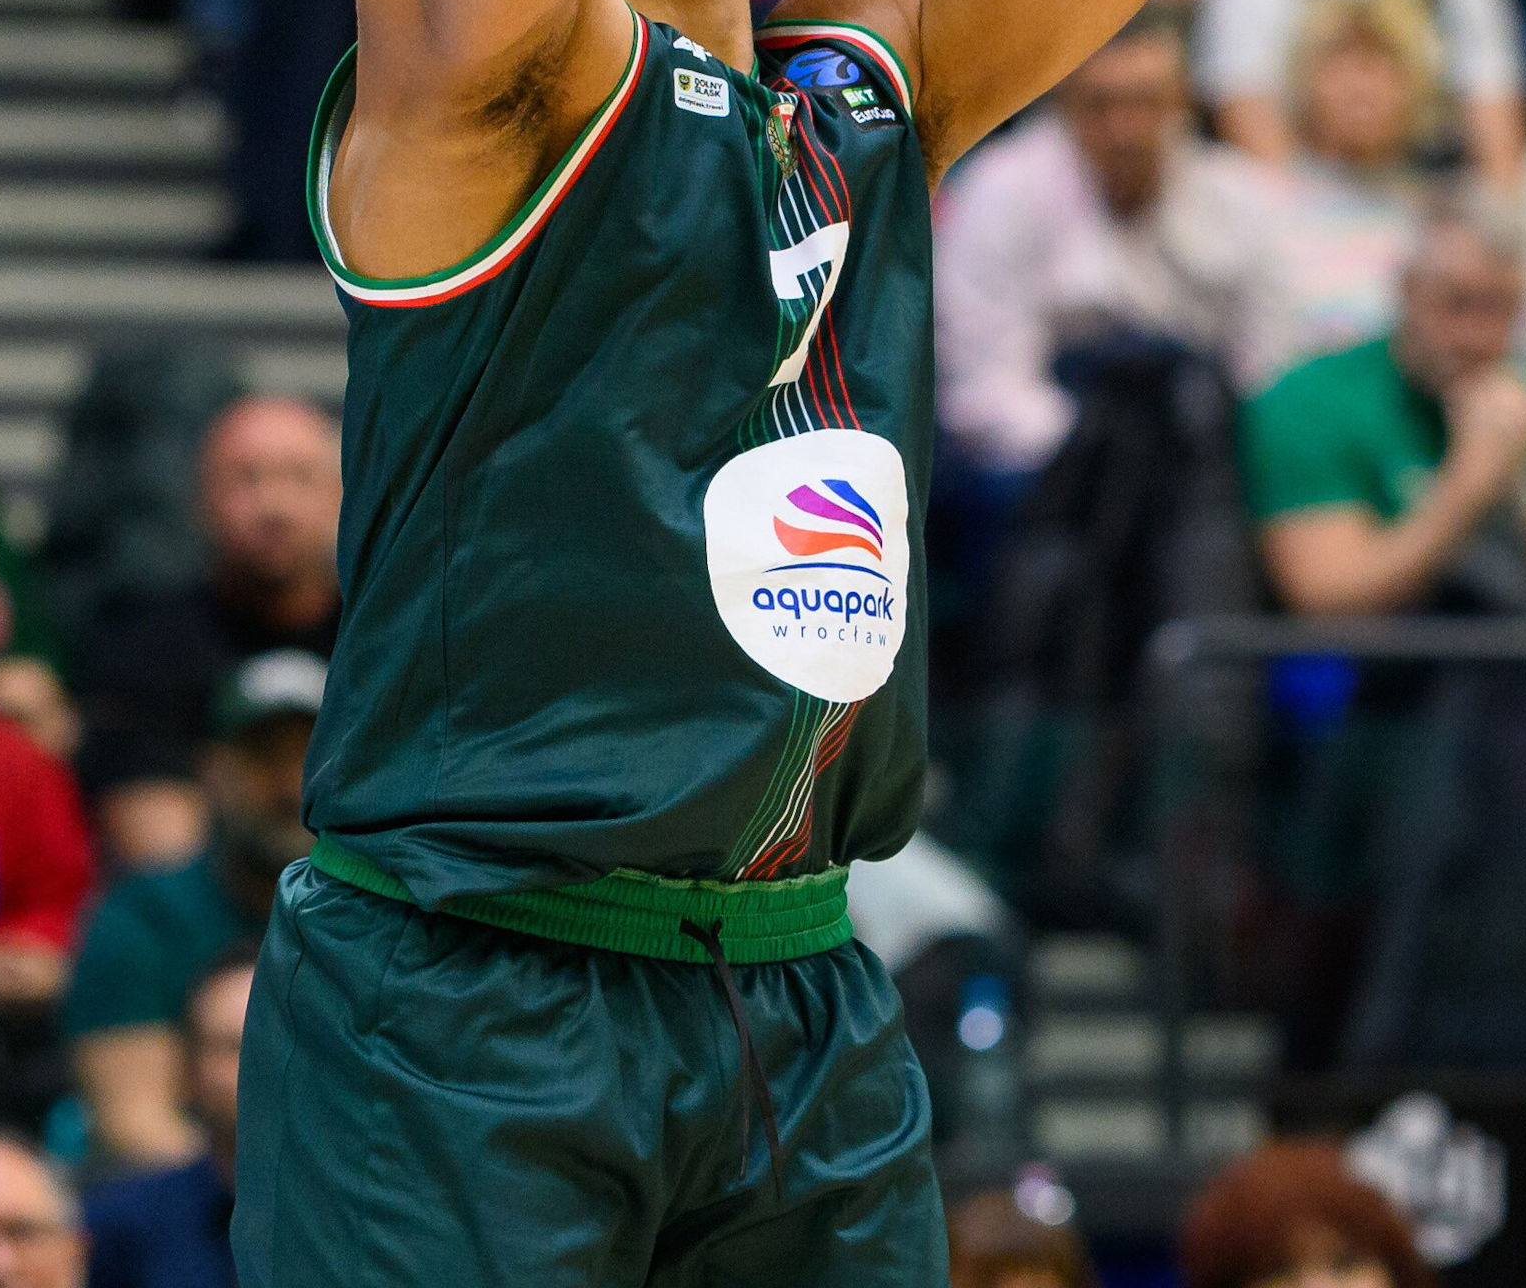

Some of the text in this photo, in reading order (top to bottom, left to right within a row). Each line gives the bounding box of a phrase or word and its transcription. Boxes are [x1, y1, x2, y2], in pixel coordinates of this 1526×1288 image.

[694, 77, 723, 90] DOLNY
[850, 106, 897, 124] EuroCup
[768, 220, 850, 388] 7
[752, 586, 894, 623] aquapark
[772, 624, 887, 647] wrocław
